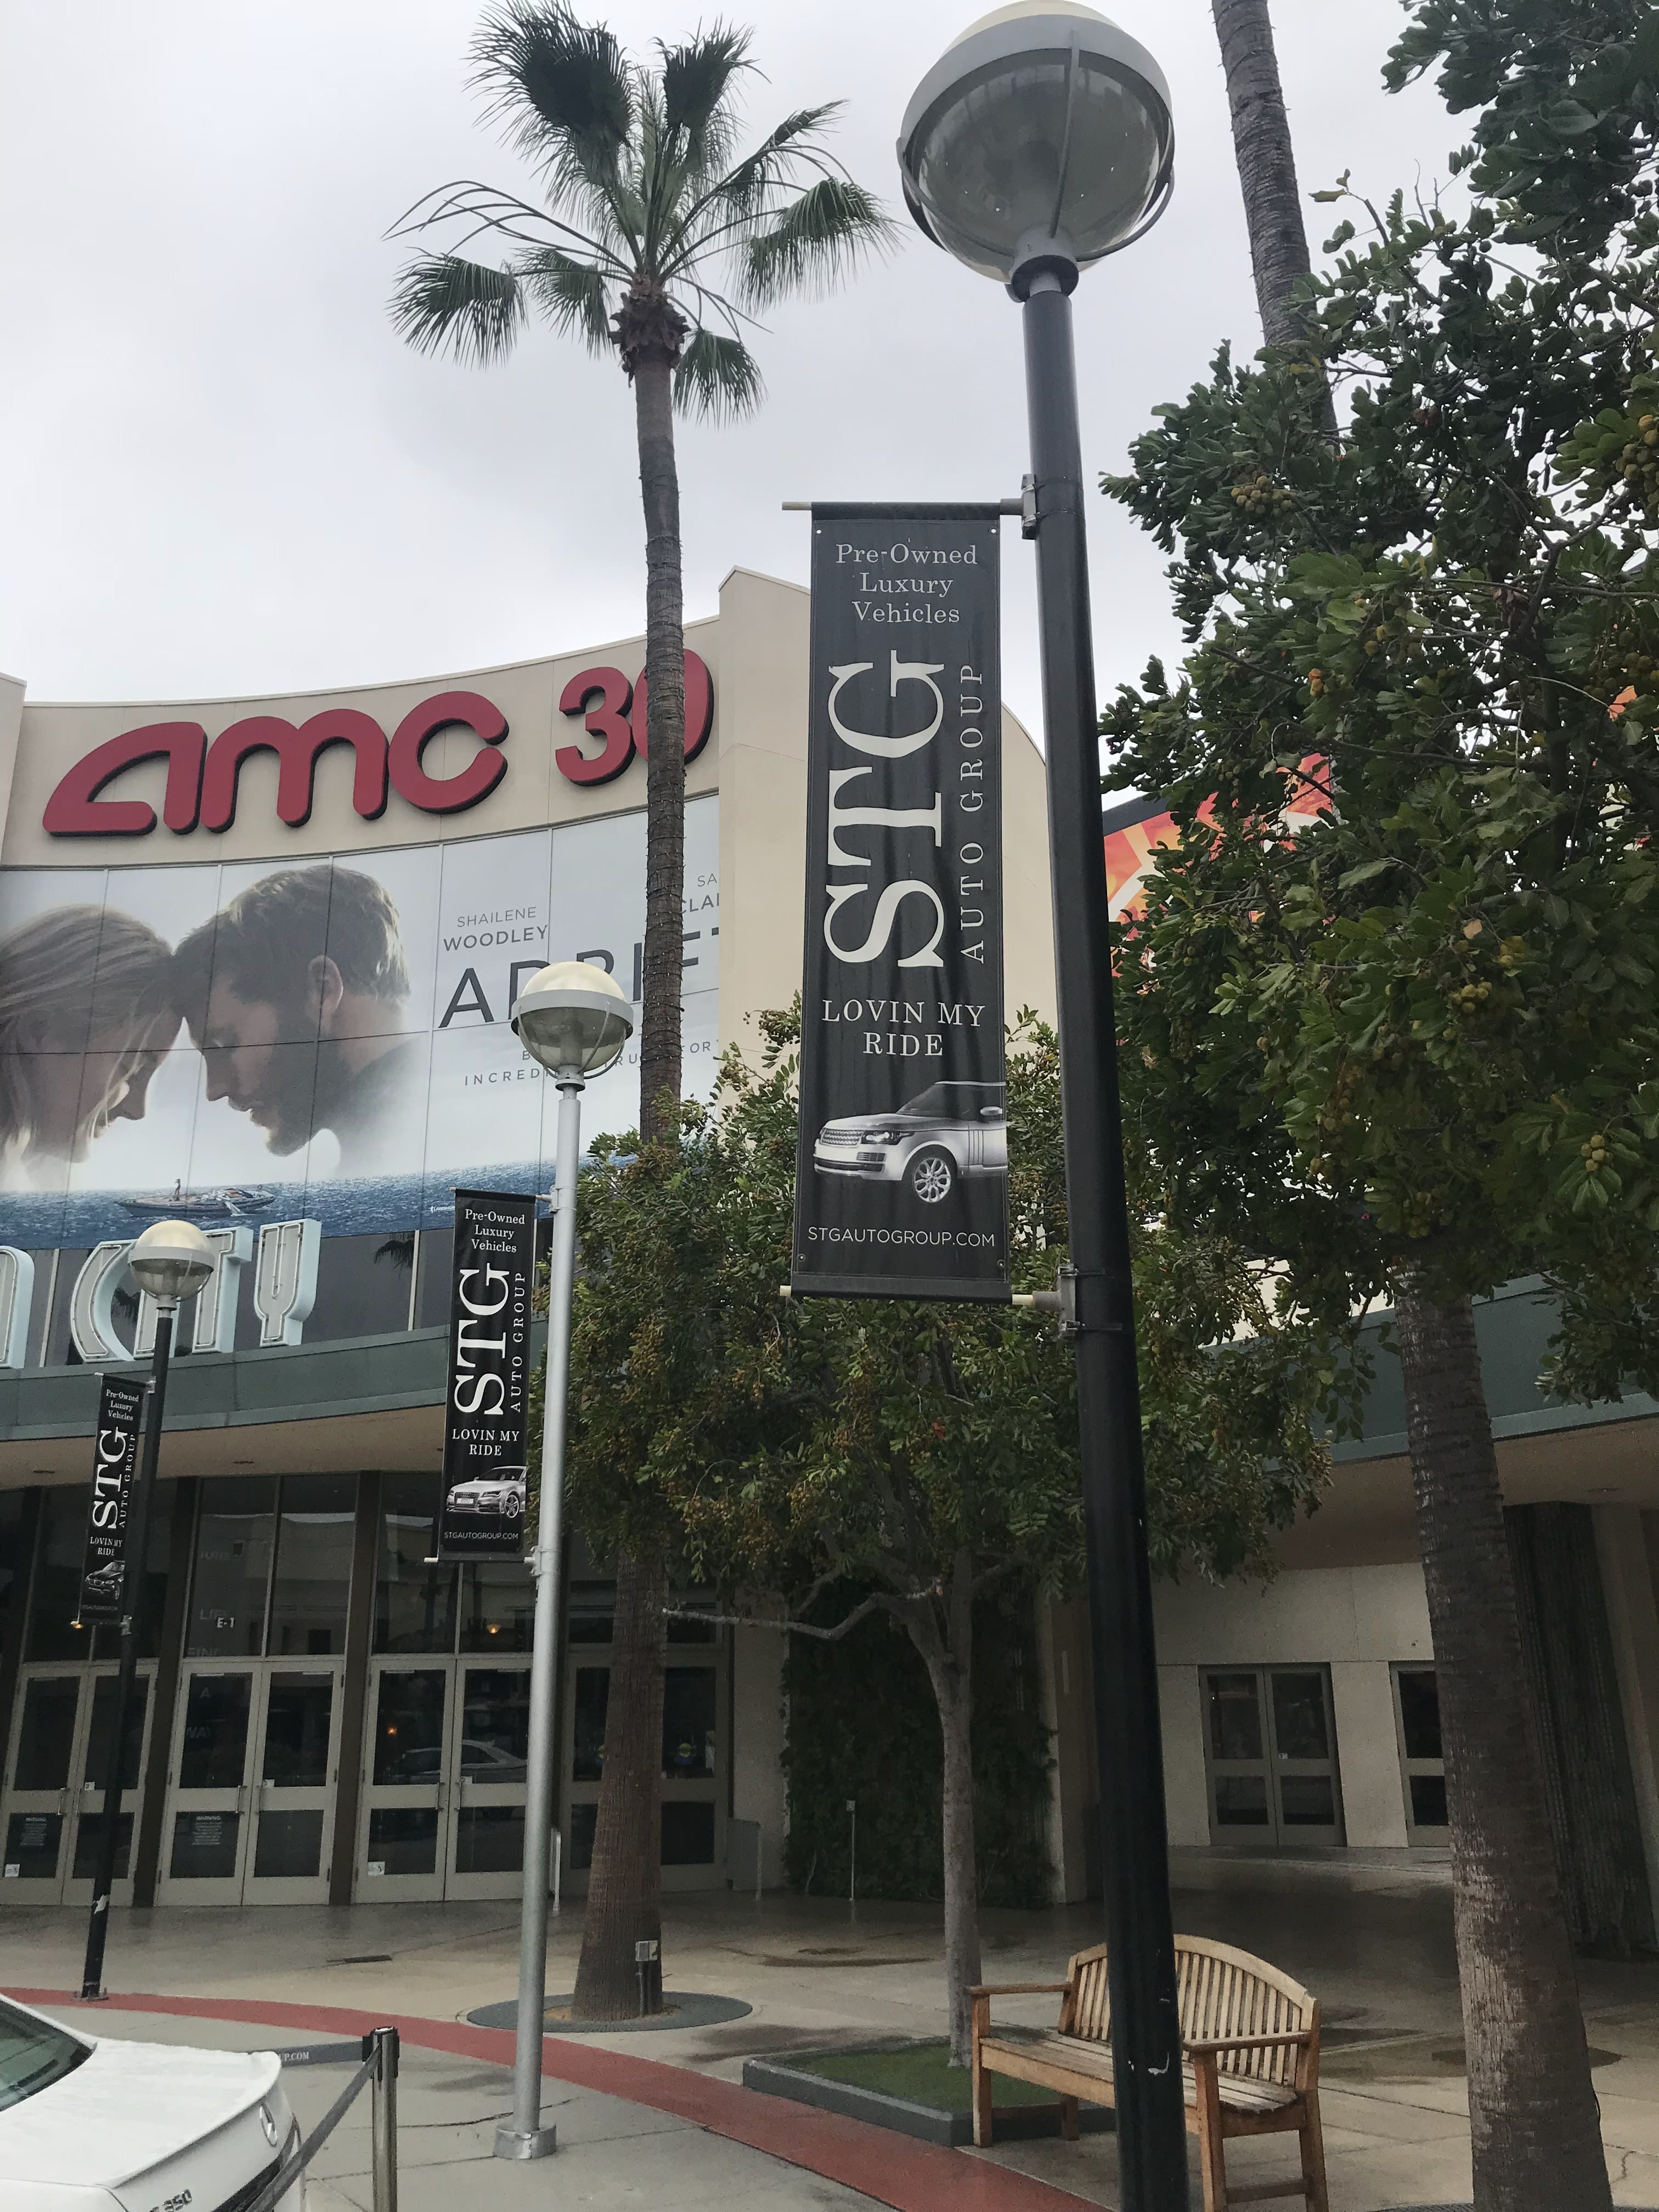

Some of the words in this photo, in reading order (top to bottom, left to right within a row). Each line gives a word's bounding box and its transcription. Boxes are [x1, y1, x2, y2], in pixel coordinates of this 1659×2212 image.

[835, 543, 978, 565] Pre-Owned
[859, 572, 953, 597] Luxury
[851, 601, 960, 624] Vehicles
[555, 648, 714, 787] 30
[960, 664, 984, 812] GROUP
[823, 650, 945, 967] STG
[960, 843, 984, 964] AUTO
[456, 906, 537, 928] SHAILENE
[443, 924, 548, 951] WOODLEY
[822, 999, 925, 1024] LOVIN
[938, 1002, 986, 1027] MY
[862, 1032, 943, 1056] RIDE
[465, 1209, 526, 1224] Pre-Owned
[475, 1224, 515, 1239] Luxury
[808, 1227, 995, 1248] STGAUTOGROUP.COM
[471, 1238, 517, 1253] Vehicles
[512, 1273, 526, 1342] GROUP
[454, 1262, 510, 1415] STG
[106, 1389, 139, 1402] Pre-Owned
[511, 1356, 523, 1413] AUTO
[108, 1409, 133, 1421] Vehicles
[110, 1400, 133, 1412] Luxury
[452, 1429, 495, 1441] LOVIN
[500, 1430, 520, 1442] MY
[469, 1444, 502, 1456] RIDE
[92, 1426, 128, 1530] STG
[119, 1489, 129, 1528] AUTO
[124, 1434, 136, 1481] GROUP
[90, 1537, 113, 1545] LOVIN
[444, 1531, 518, 1540] STGAUTOGROUP.COM
[97, 1547, 115, 1556] RIDE
[217, 1617, 235, 1628] E-1
